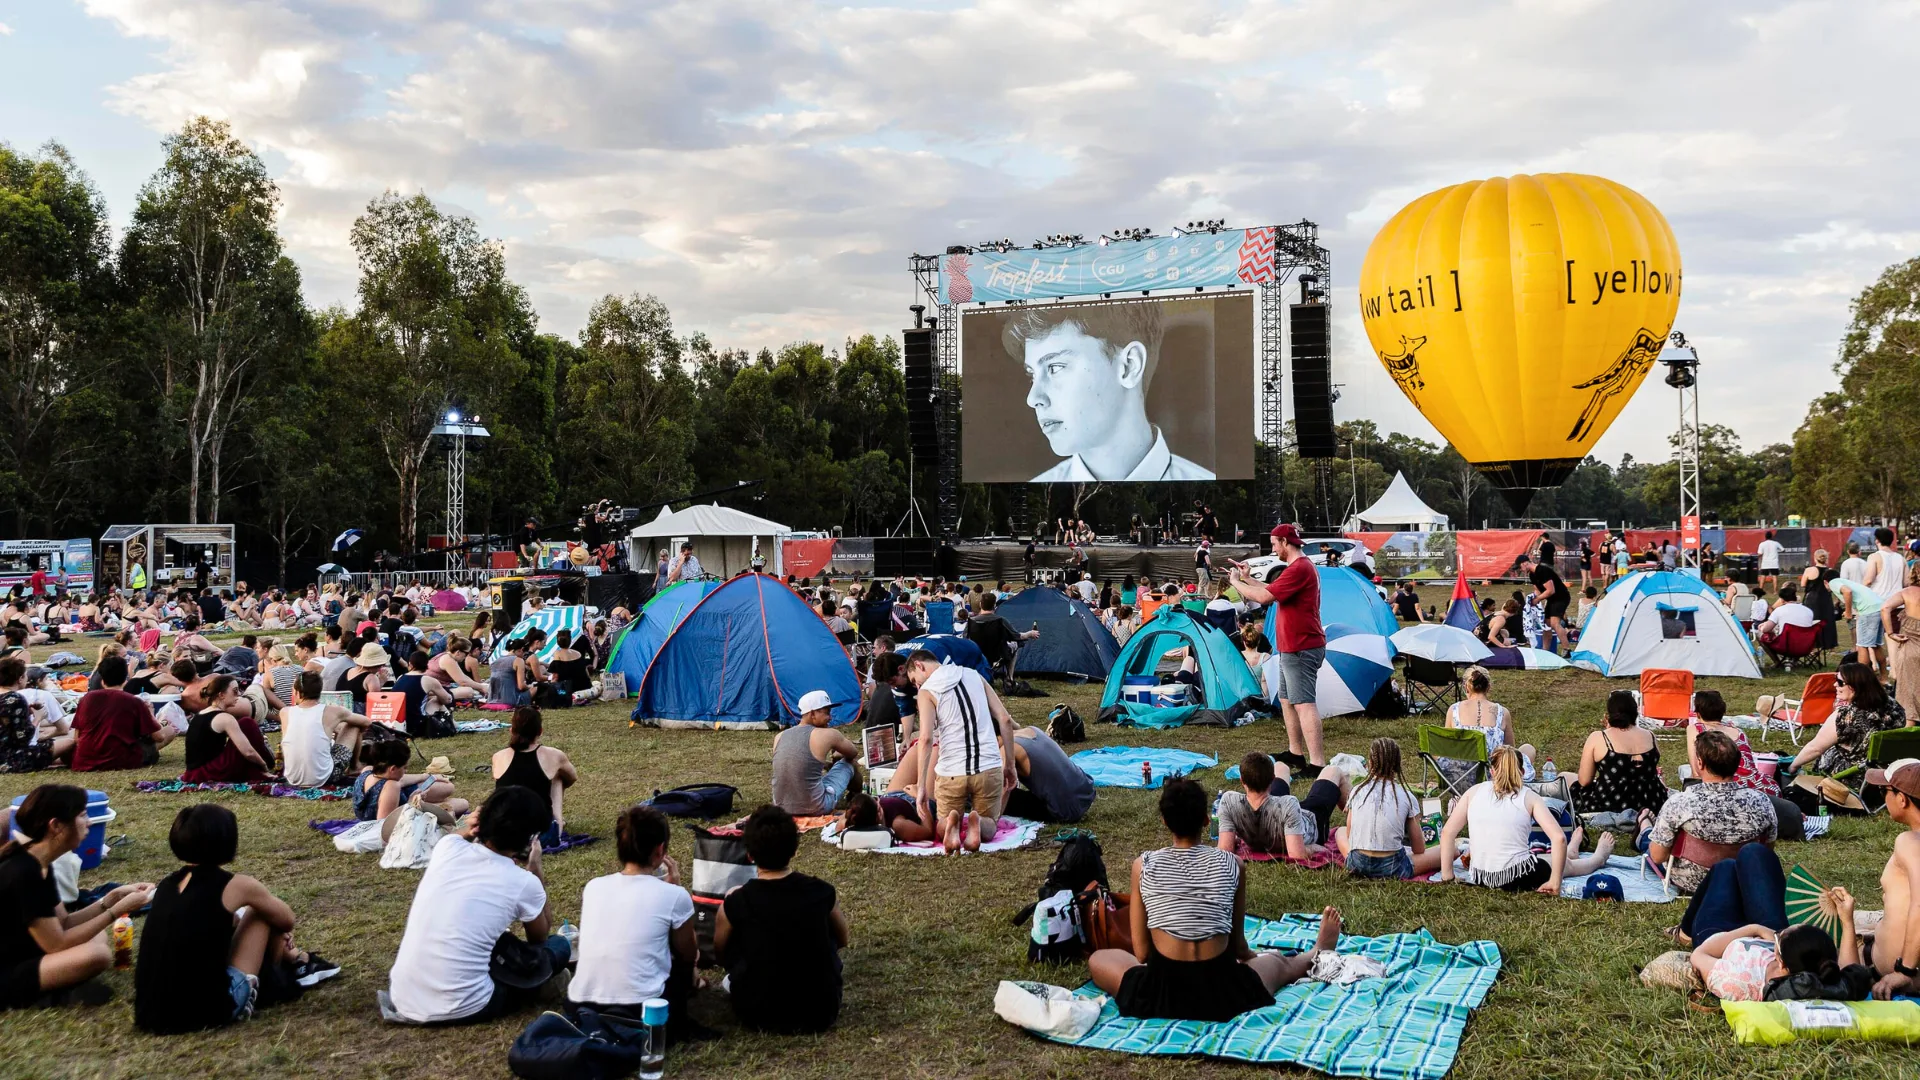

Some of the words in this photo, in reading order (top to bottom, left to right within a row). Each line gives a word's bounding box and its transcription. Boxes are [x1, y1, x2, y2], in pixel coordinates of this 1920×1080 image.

[984, 258, 1069, 295] Tropfest
[1099, 264, 1125, 276] CGU
[1592, 260, 1673, 305] yellow
[1388, 275, 1435, 314] tail
